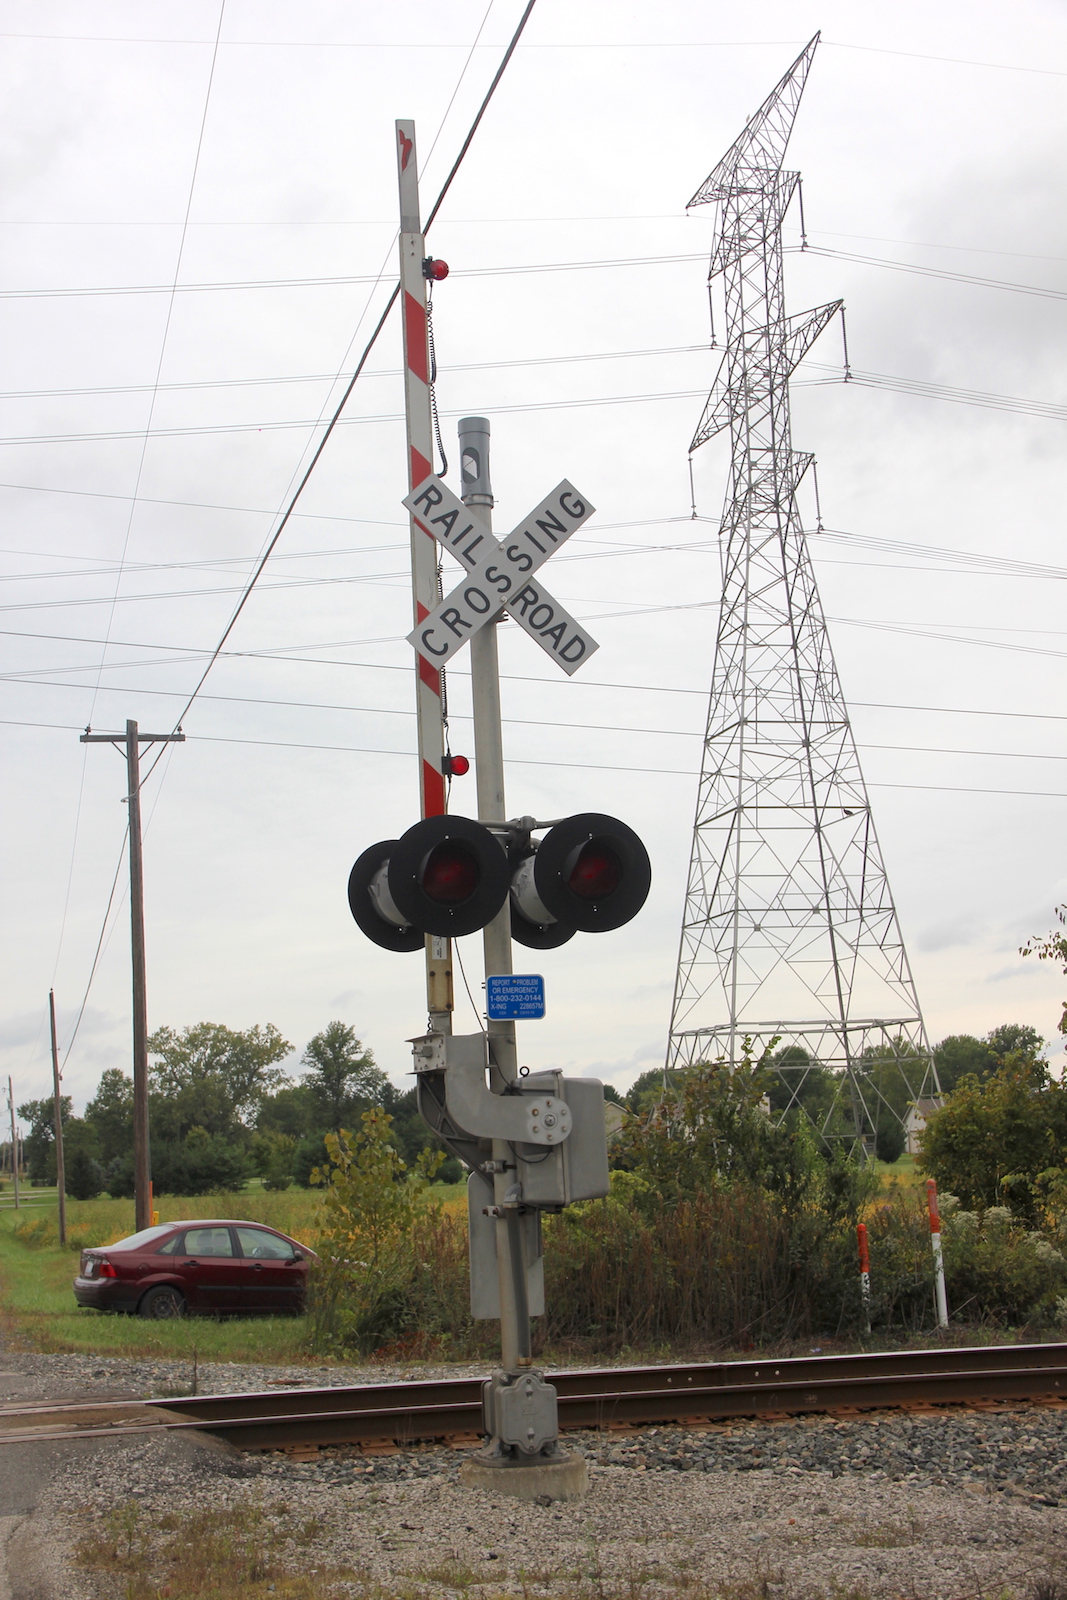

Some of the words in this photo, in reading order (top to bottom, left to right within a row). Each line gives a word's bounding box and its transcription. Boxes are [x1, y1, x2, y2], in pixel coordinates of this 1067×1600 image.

[413, 484, 484, 566] RAIL
[510, 584, 586, 663] ROAD
[421, 492, 586, 656] CROSSING
